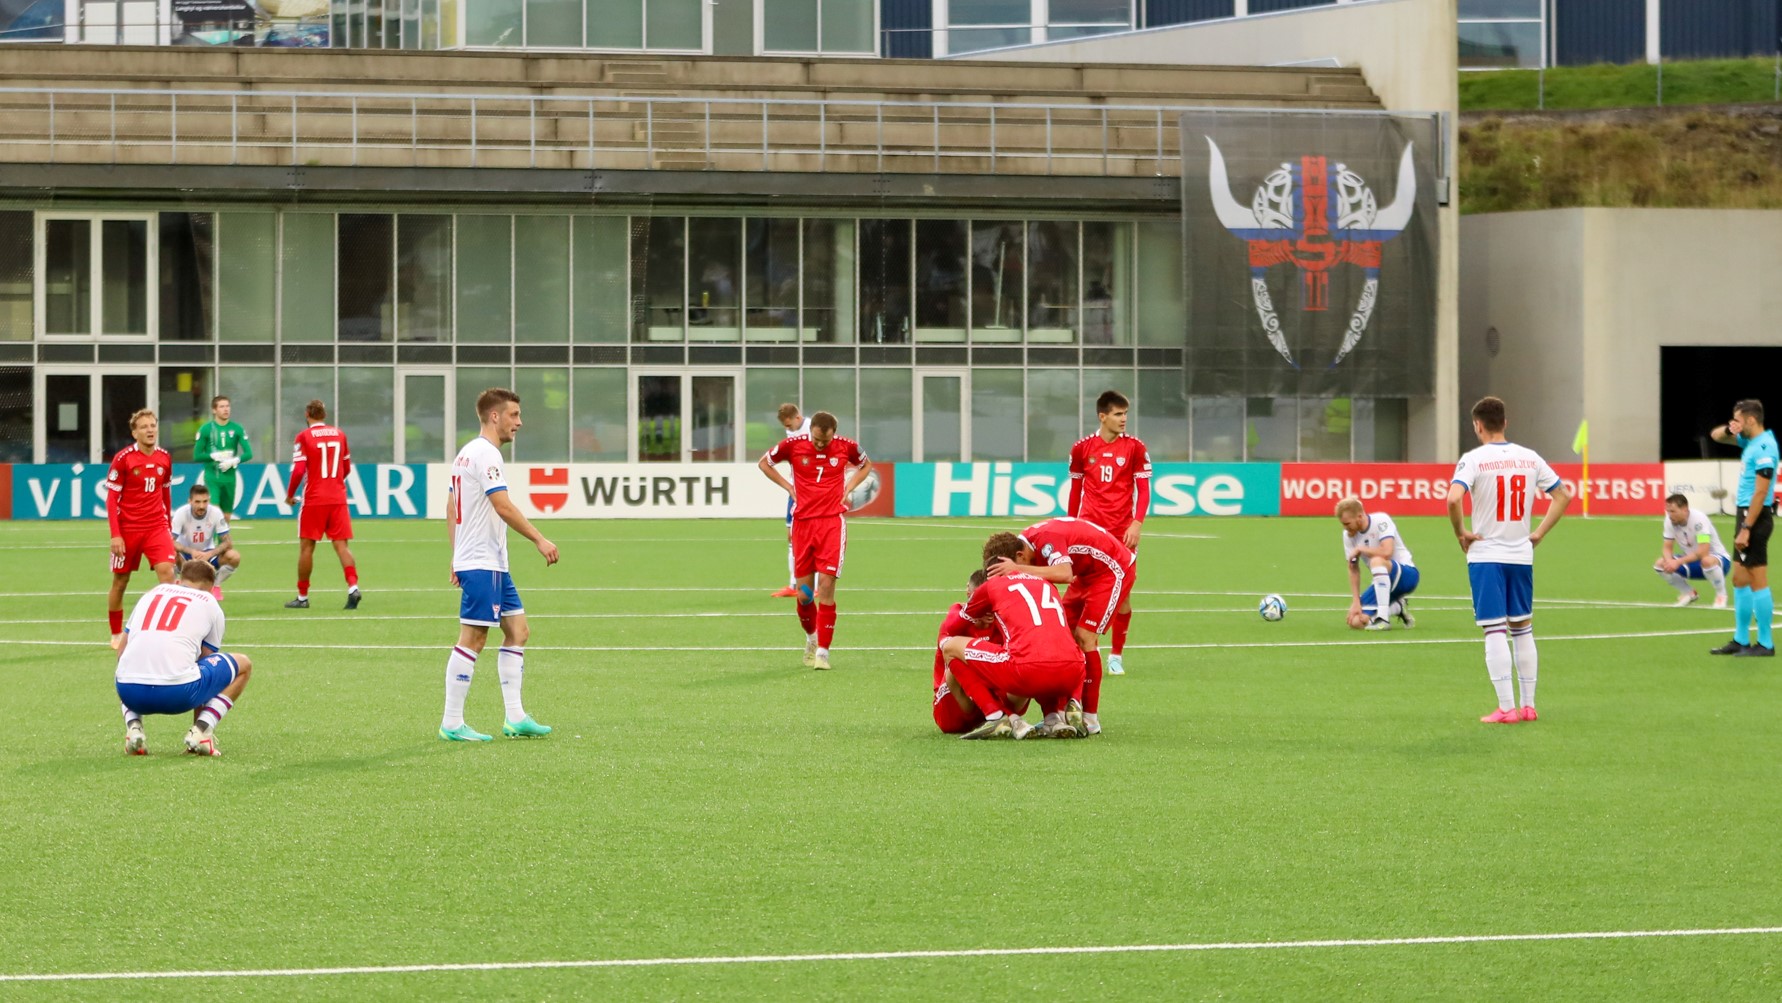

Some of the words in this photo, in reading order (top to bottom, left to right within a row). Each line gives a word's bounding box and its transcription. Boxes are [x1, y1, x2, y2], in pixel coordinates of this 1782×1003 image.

[317, 441, 341, 479] 17
[816, 466, 824, 483] 7
[1100, 465, 1113, 483] 19
[144, 477, 156, 493] 18
[932, 462, 1245, 516] Hisse
[1282, 478, 1452, 500] WORLDFIRS
[1496, 474, 1526, 522] 18
[192, 531, 205, 544] 20
[141, 594, 193, 632] 16
[1007, 582, 1067, 628] 14
